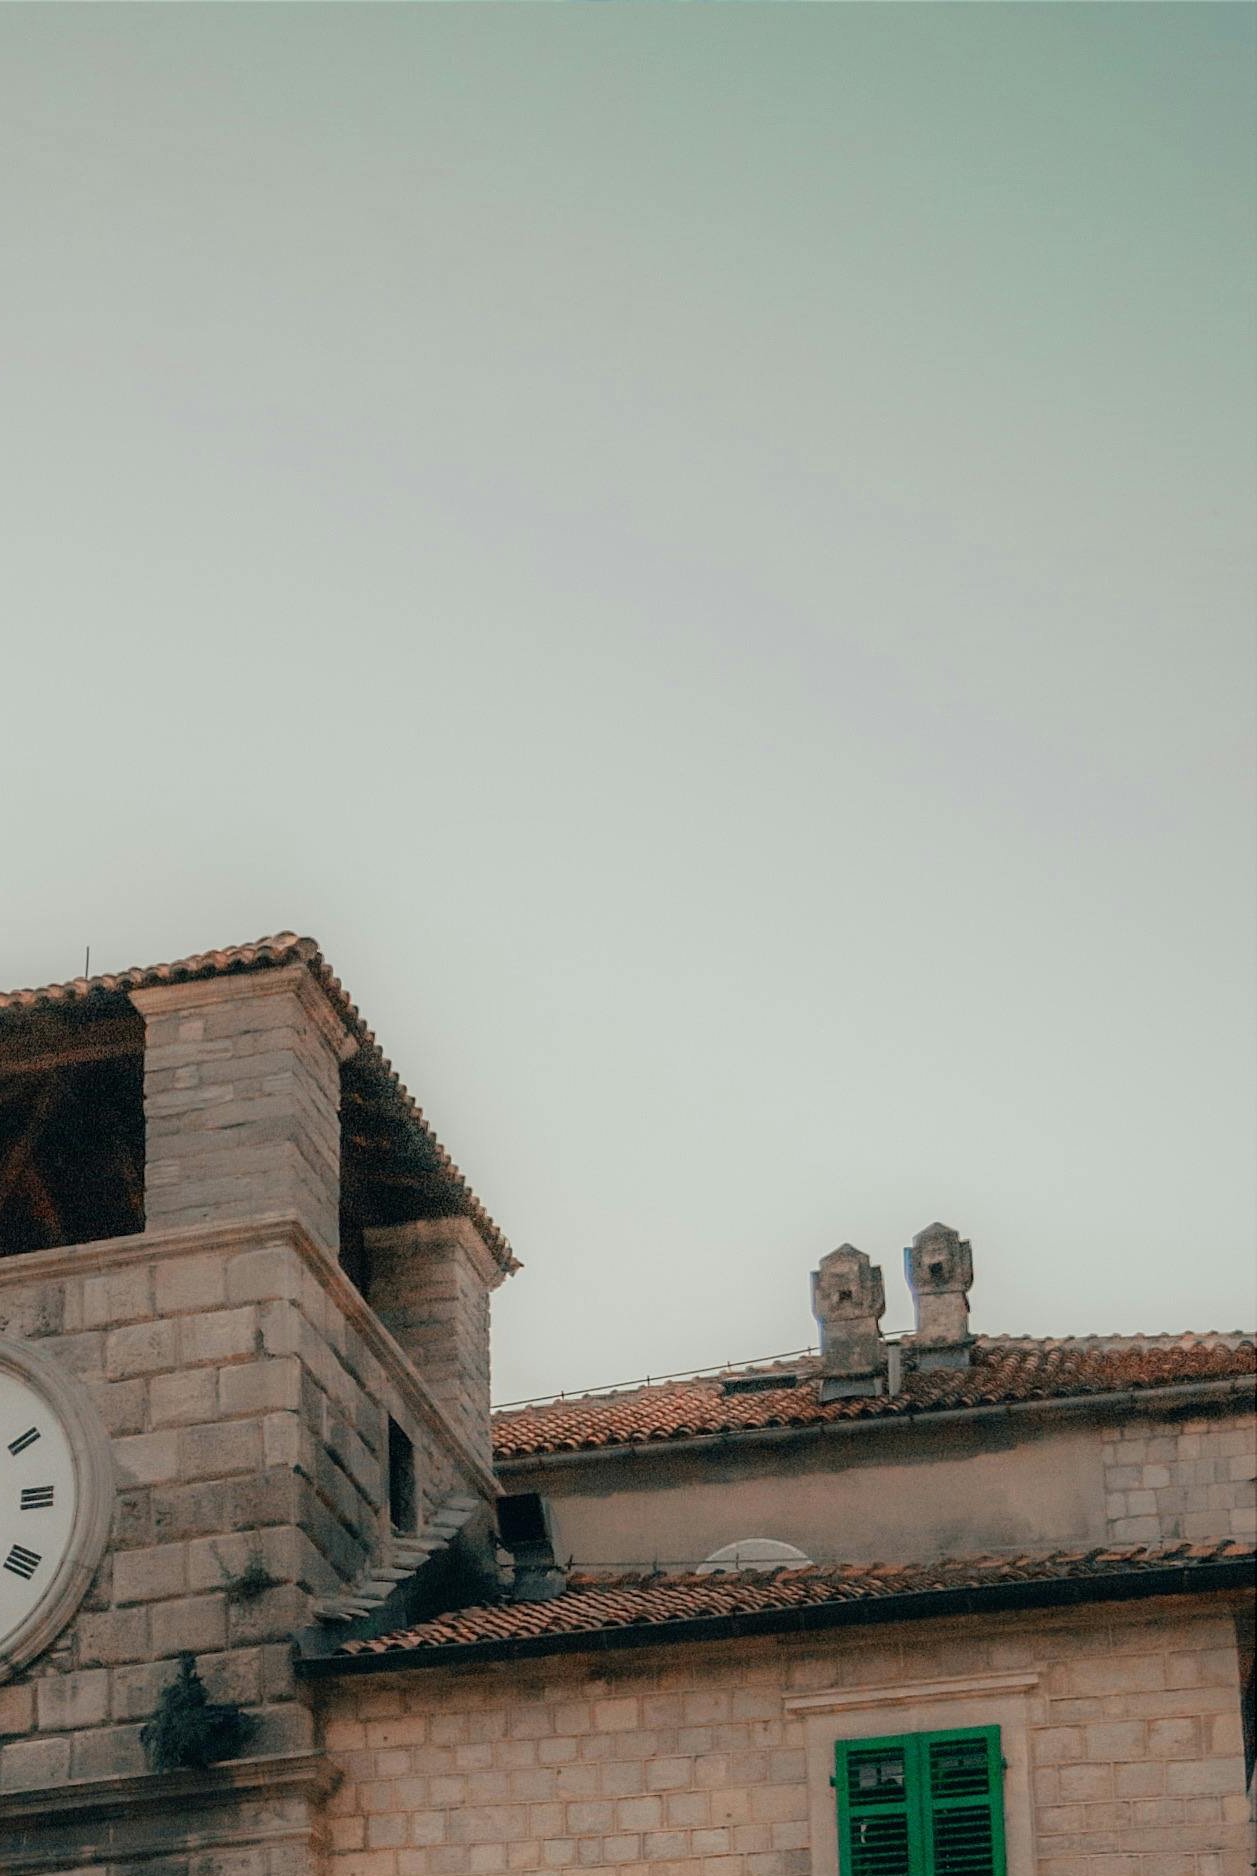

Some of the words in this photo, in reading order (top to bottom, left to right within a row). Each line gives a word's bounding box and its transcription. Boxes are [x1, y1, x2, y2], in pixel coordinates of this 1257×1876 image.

[7, 1427, 41, 1456] II
[20, 1485, 54, 1510] III
[3, 1544, 42, 1580] IIII
